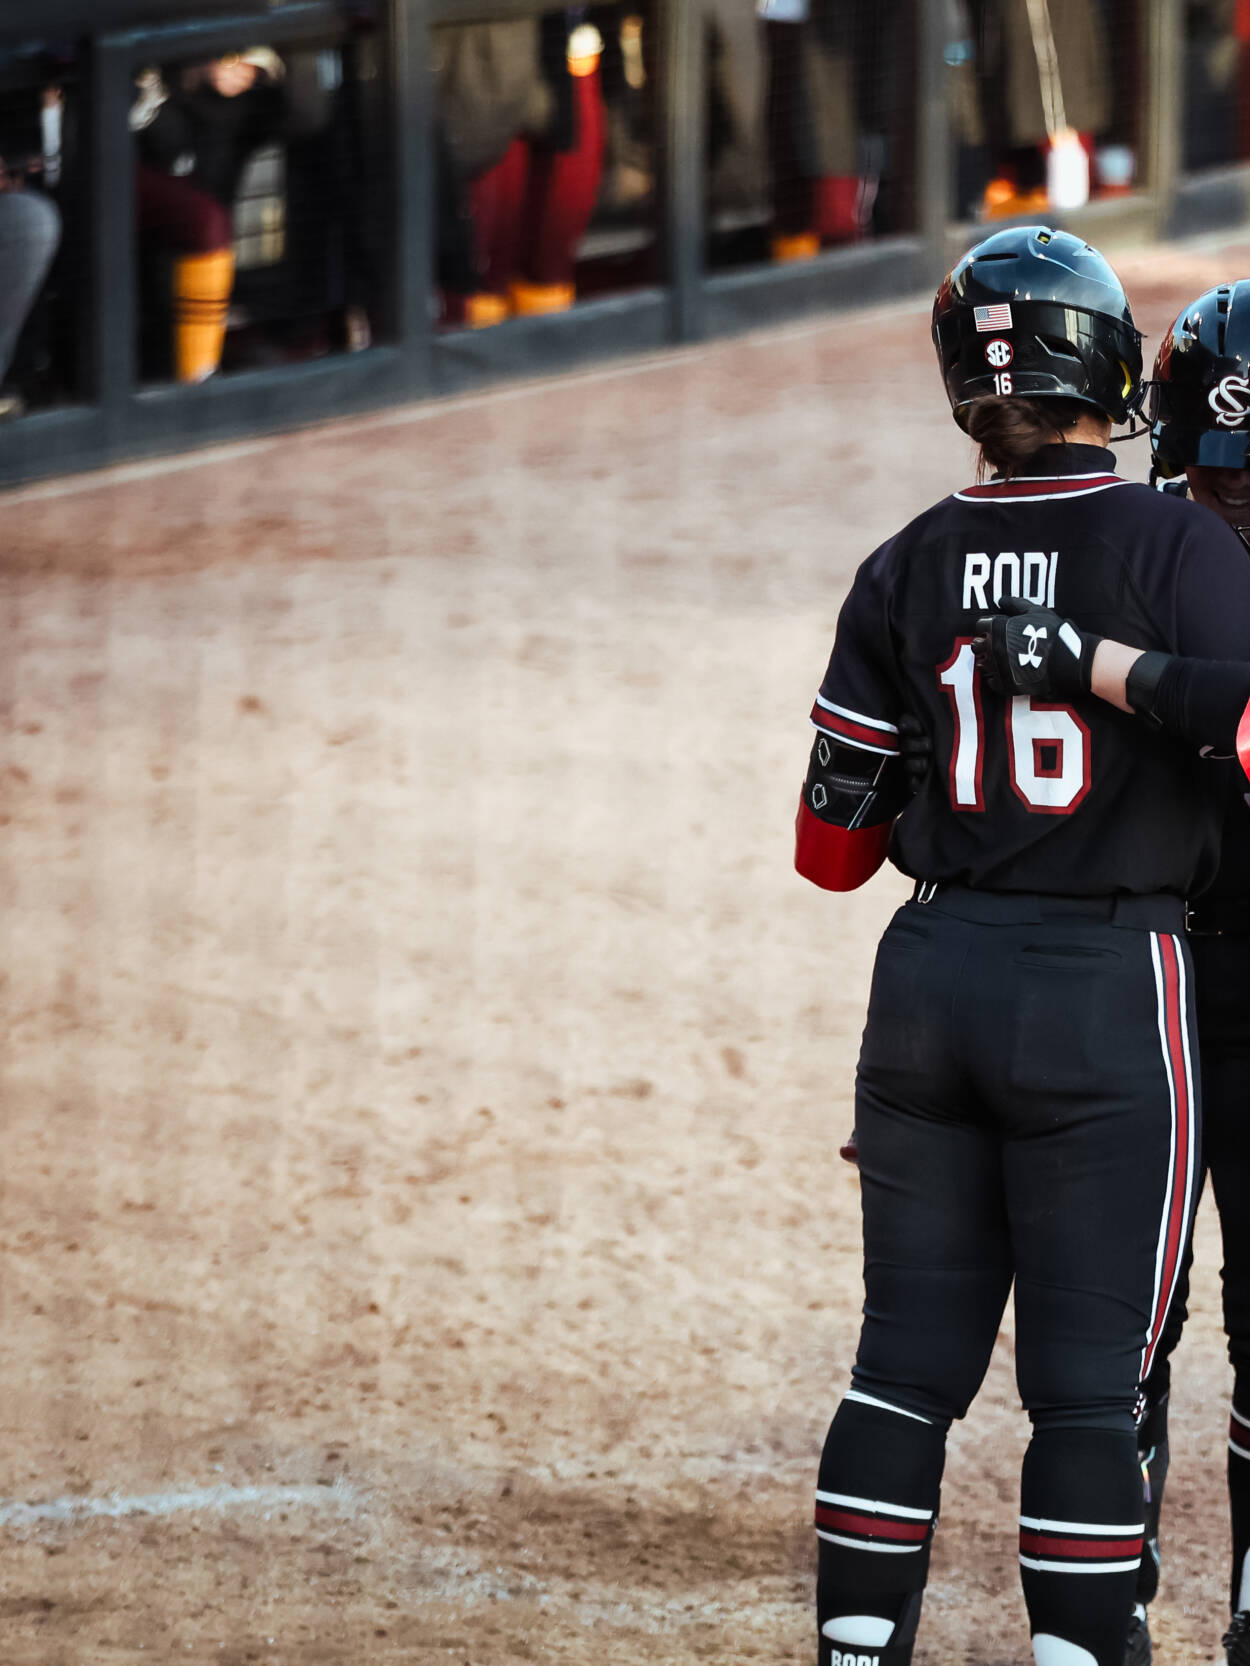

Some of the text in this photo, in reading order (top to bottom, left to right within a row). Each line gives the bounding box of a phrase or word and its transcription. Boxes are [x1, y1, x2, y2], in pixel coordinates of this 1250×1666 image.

[986, 340, 1011, 367] SEC
[993, 373, 1012, 396] 16
[962, 551, 1059, 610] RODI
[936, 636, 1092, 815] 16
